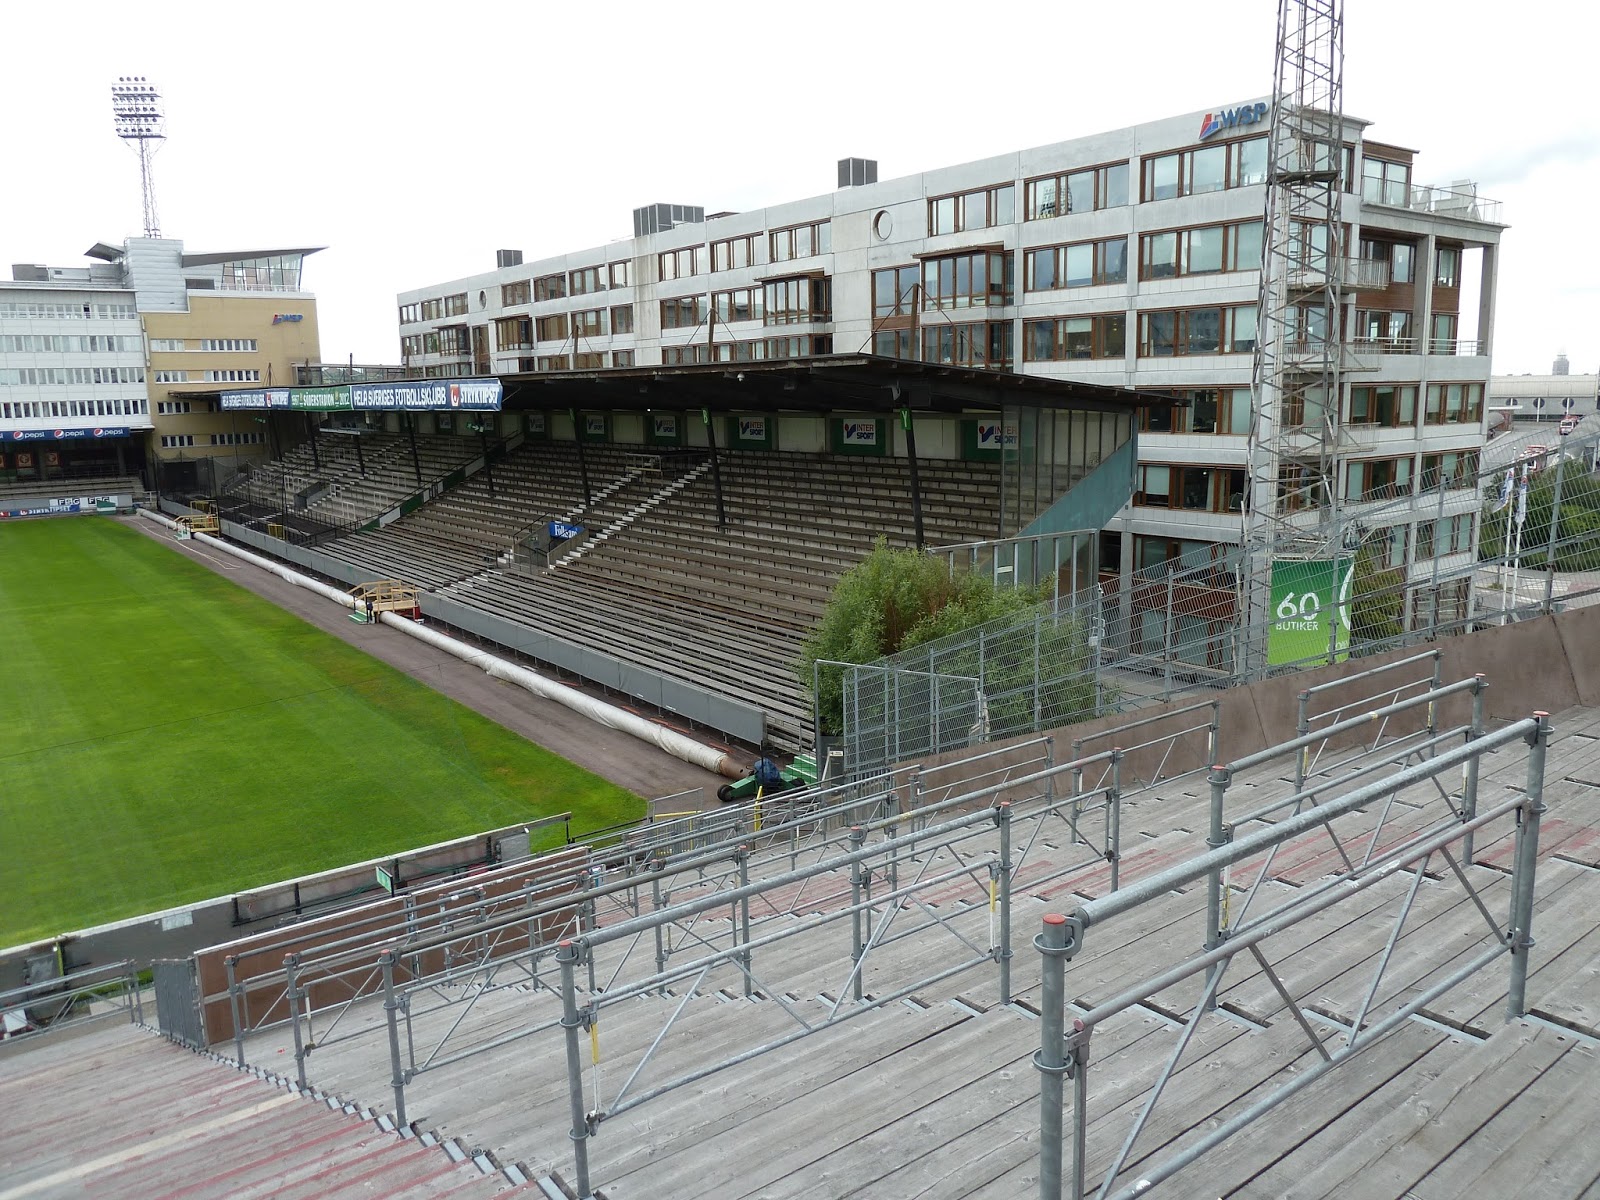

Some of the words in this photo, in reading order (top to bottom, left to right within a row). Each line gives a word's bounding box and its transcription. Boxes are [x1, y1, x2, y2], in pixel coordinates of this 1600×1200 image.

[1221, 102, 1268, 128] WSP
[353, 390, 368, 406] HELA
[368, 389, 395, 406] SVERIGES
[395, 386, 447, 406] FOTBOLLSKLUBB
[902, 410, 908, 428] Y
[64, 428, 85, 437] pepsi
[104, 428, 124, 436] pepsi
[857, 424, 874, 432] INTER
[24, 431, 45, 439] pepsi
[857, 432, 874, 440] SPORT
[1276, 592, 1319, 621] 60
[1276, 621, 1319, 631] BUTIKER
